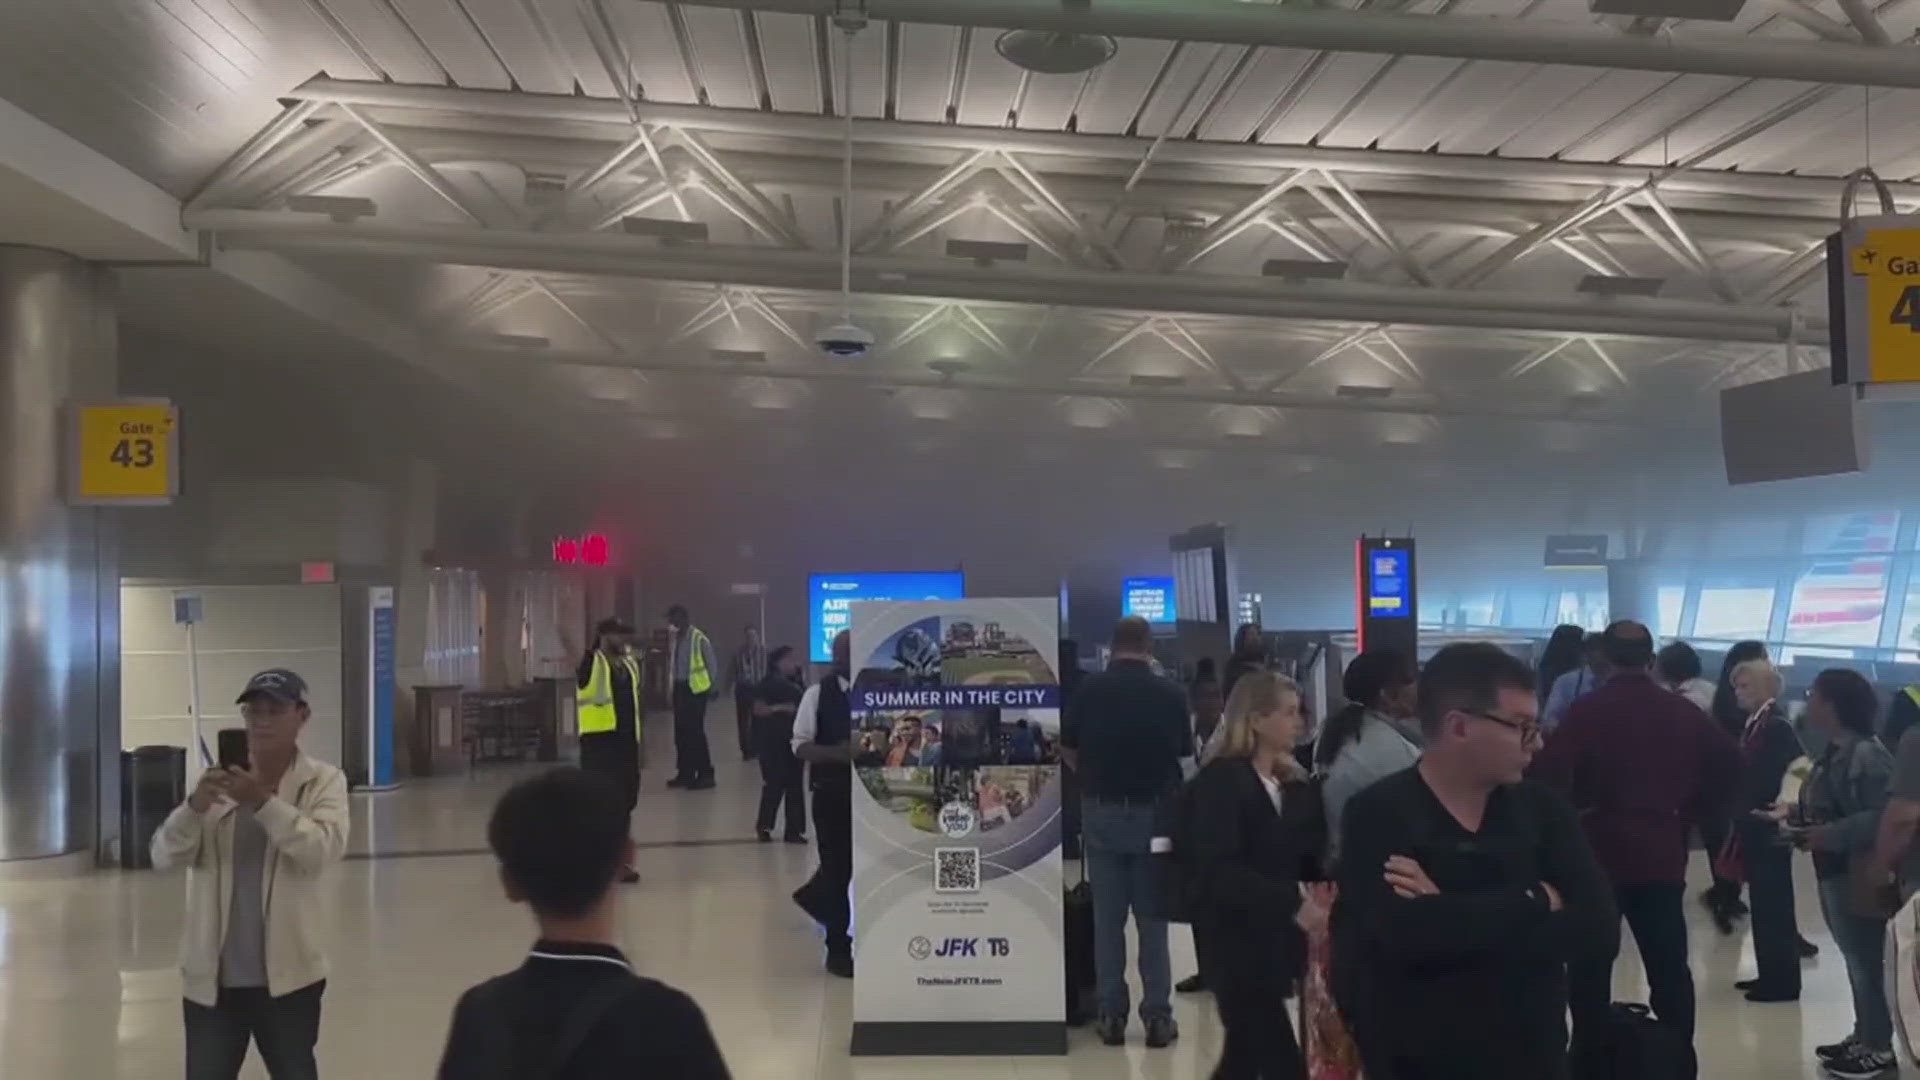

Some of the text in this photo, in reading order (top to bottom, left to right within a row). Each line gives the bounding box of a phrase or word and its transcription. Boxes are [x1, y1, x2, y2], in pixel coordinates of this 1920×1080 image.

[120, 422, 154, 434] Gate
[109, 439, 154, 468] 43
[864, 689, 1046, 707] SUMMER IN THE CITY
[935, 938, 1009, 957] JFK T8
